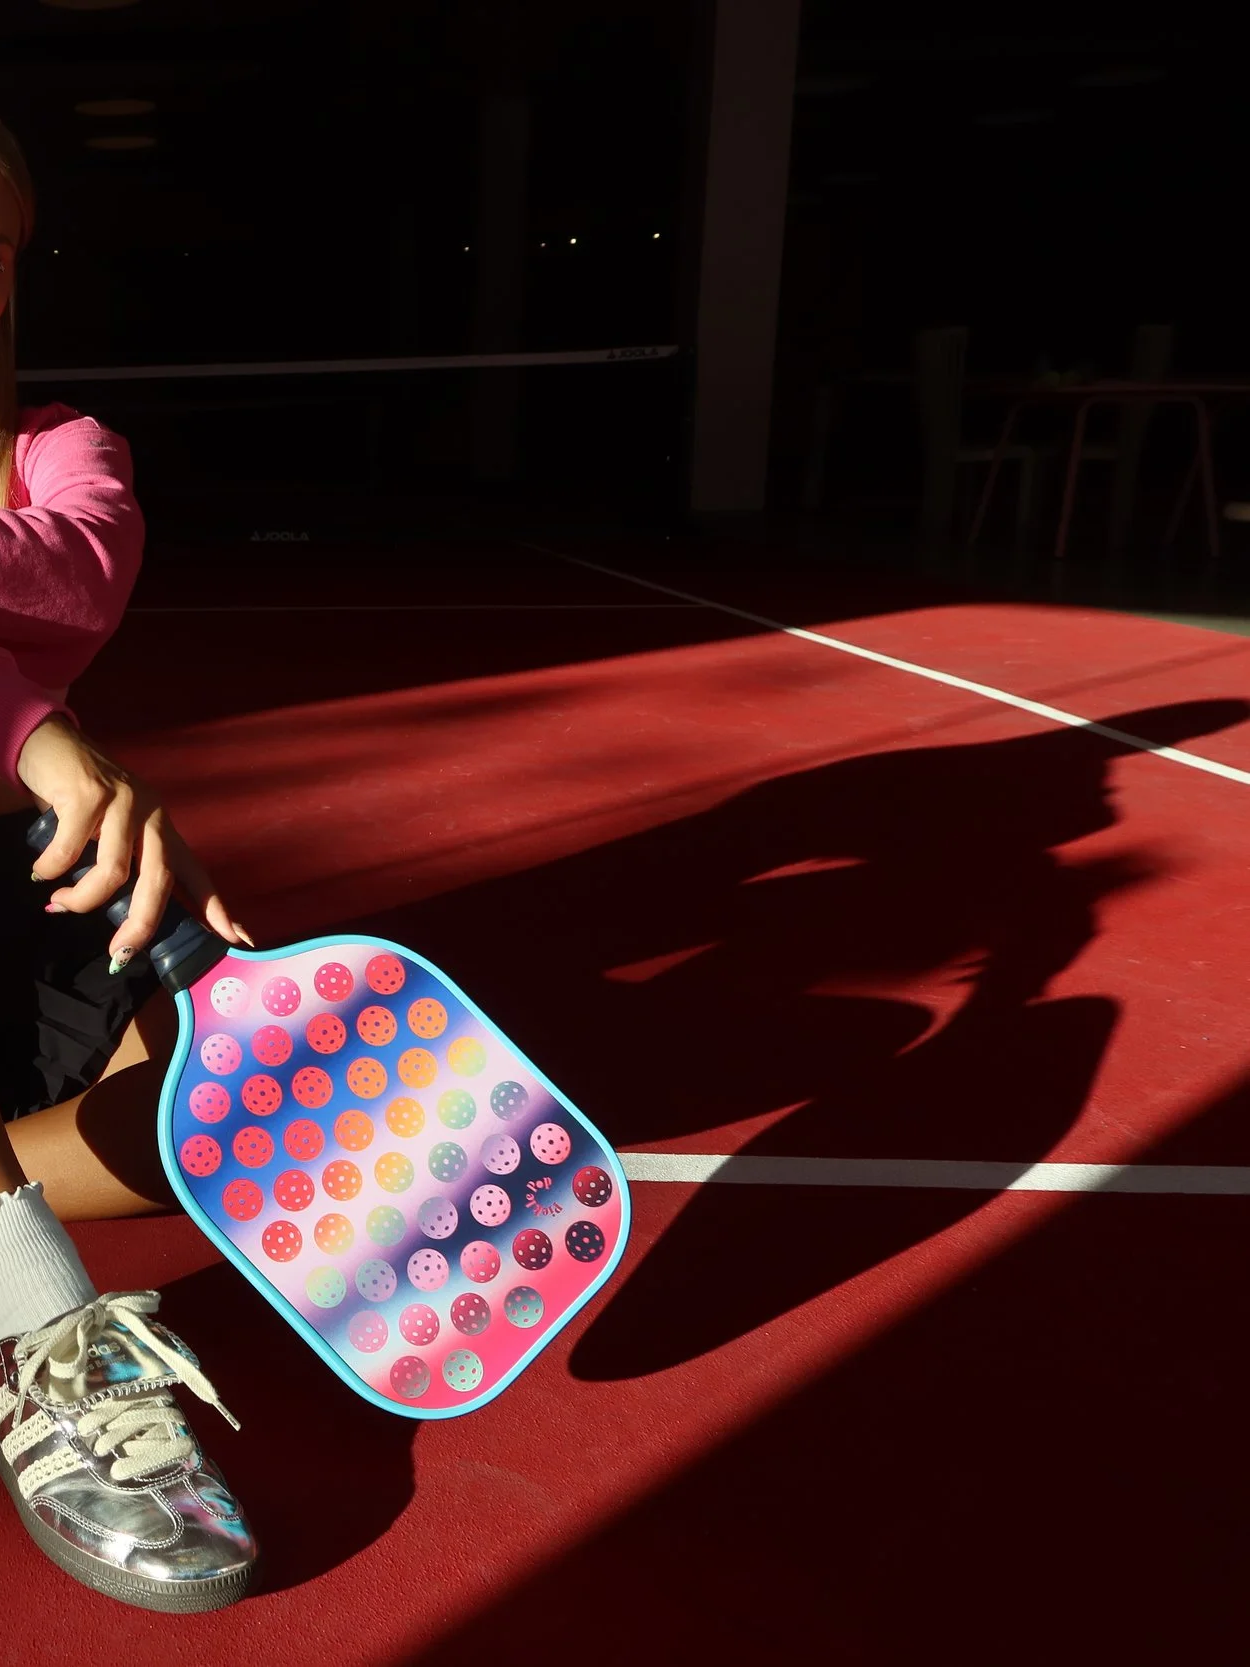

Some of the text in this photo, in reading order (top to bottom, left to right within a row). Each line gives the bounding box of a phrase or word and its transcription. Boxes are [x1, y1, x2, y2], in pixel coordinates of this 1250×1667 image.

[619, 347, 658, 358] JOOLA
[262, 531, 310, 541] JOOLA
[87, 1342, 121, 1358] das
